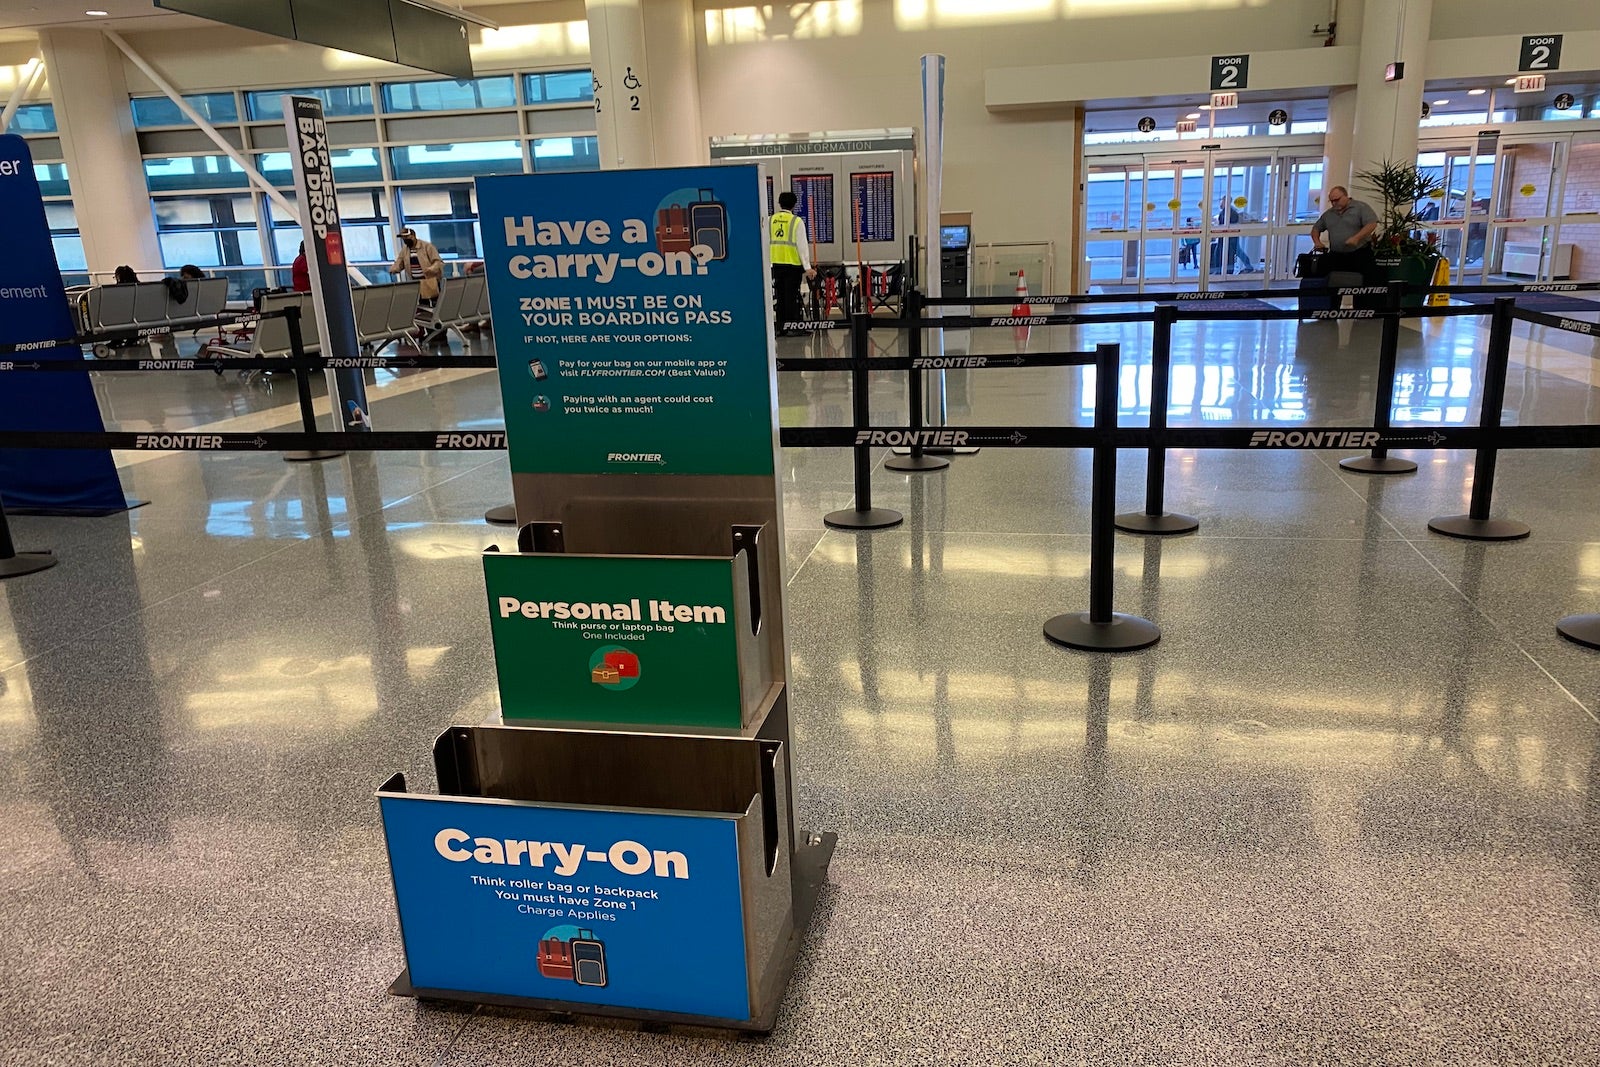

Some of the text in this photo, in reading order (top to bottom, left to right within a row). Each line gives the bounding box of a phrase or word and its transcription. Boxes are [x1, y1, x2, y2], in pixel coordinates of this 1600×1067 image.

[1529, 37, 1555, 46] DOOR
[1218, 57, 1242, 66] DOOR
[1530, 46, 1550, 69] 2
[1220, 65, 1238, 87] 2
[1520, 77, 1541, 90] EXIT
[630, 96, 640, 111] 2
[1214, 95, 1235, 107] EXIT
[1561, 94, 1569, 102] 2
[595, 98, 602, 113] 2
[1271, 117, 1284, 125] UL
[1178, 122, 1194, 132] EXIT
[750, 141, 872, 155] FLIGHT INFORMATION
[0, 159, 20, 175] er
[314, 118, 337, 225] EXPRESS
[298, 117, 328, 240] BAG DROP
[504, 216, 648, 247] Have a
[508, 244, 714, 284] carry-on?
[1338, 287, 1389, 296] FRONTIER
[1523, 284, 1578, 292] FRONTIER
[1023, 296, 1069, 304] FRONTIER
[1176, 291, 1225, 300] FRONTIER
[520, 294, 702, 311] ZONE 1 MUST BE ON
[234, 313, 262, 323] FRONTIER
[521, 310, 732, 327] YOUR BOARDING PASS
[1311, 309, 1375, 319] FRONTIER
[783, 320, 835, 330] FRONTIER
[990, 316, 1048, 326] FRONTIER
[1559, 318, 1592, 333] FRONTIER
[138, 326, 171, 336] FRONTIER
[524, 334, 693, 344] IF NOT, HERE ARE YOUR OPTIONS:
[15, 340, 56, 351] FRONTIER
[0, 361, 14, 370] ER
[139, 360, 195, 370] FRONTIER
[327, 358, 387, 368] FRONTIER
[559, 360, 575, 369] Pay
[577, 359, 591, 367] for
[591, 361, 612, 369] your
[614, 359, 632, 369] bag
[664, 359, 696, 367] mobile
[697, 360, 715, 369] app
[912, 357, 988, 369] FRONTIER
[560, 368, 726, 377] visit FLYFRONTIER.COM (Best Value!)
[563, 395, 595, 405] Paying
[597, 395, 618, 403] with
[633, 395, 662, 405] agent
[663, 395, 691, 403] could
[693, 395, 714, 403] cost
[564, 407, 582, 415] you
[584, 405, 610, 414] twice
[624, 404, 654, 414] much!
[135, 434, 223, 449] FRONTIER
[855, 430, 970, 446] FRONTIER
[1249, 431, 1380, 447] FRONTIER
[607, 452, 662, 462] FRONTIER
[498, 596, 726, 624] Personal Item
[552, 621, 578, 630] Think
[580, 623, 607, 632] purse
[622, 623, 653, 633] laptop
[655, 624, 674, 633] bag
[582, 631, 645, 641] One Included
[434, 828, 690, 880] Carry-On
[471, 875, 659, 900] Think roller bag or backpack
[495, 890, 637, 911] You must have Zone 1
[517, 904, 617, 922] Charge Applies
